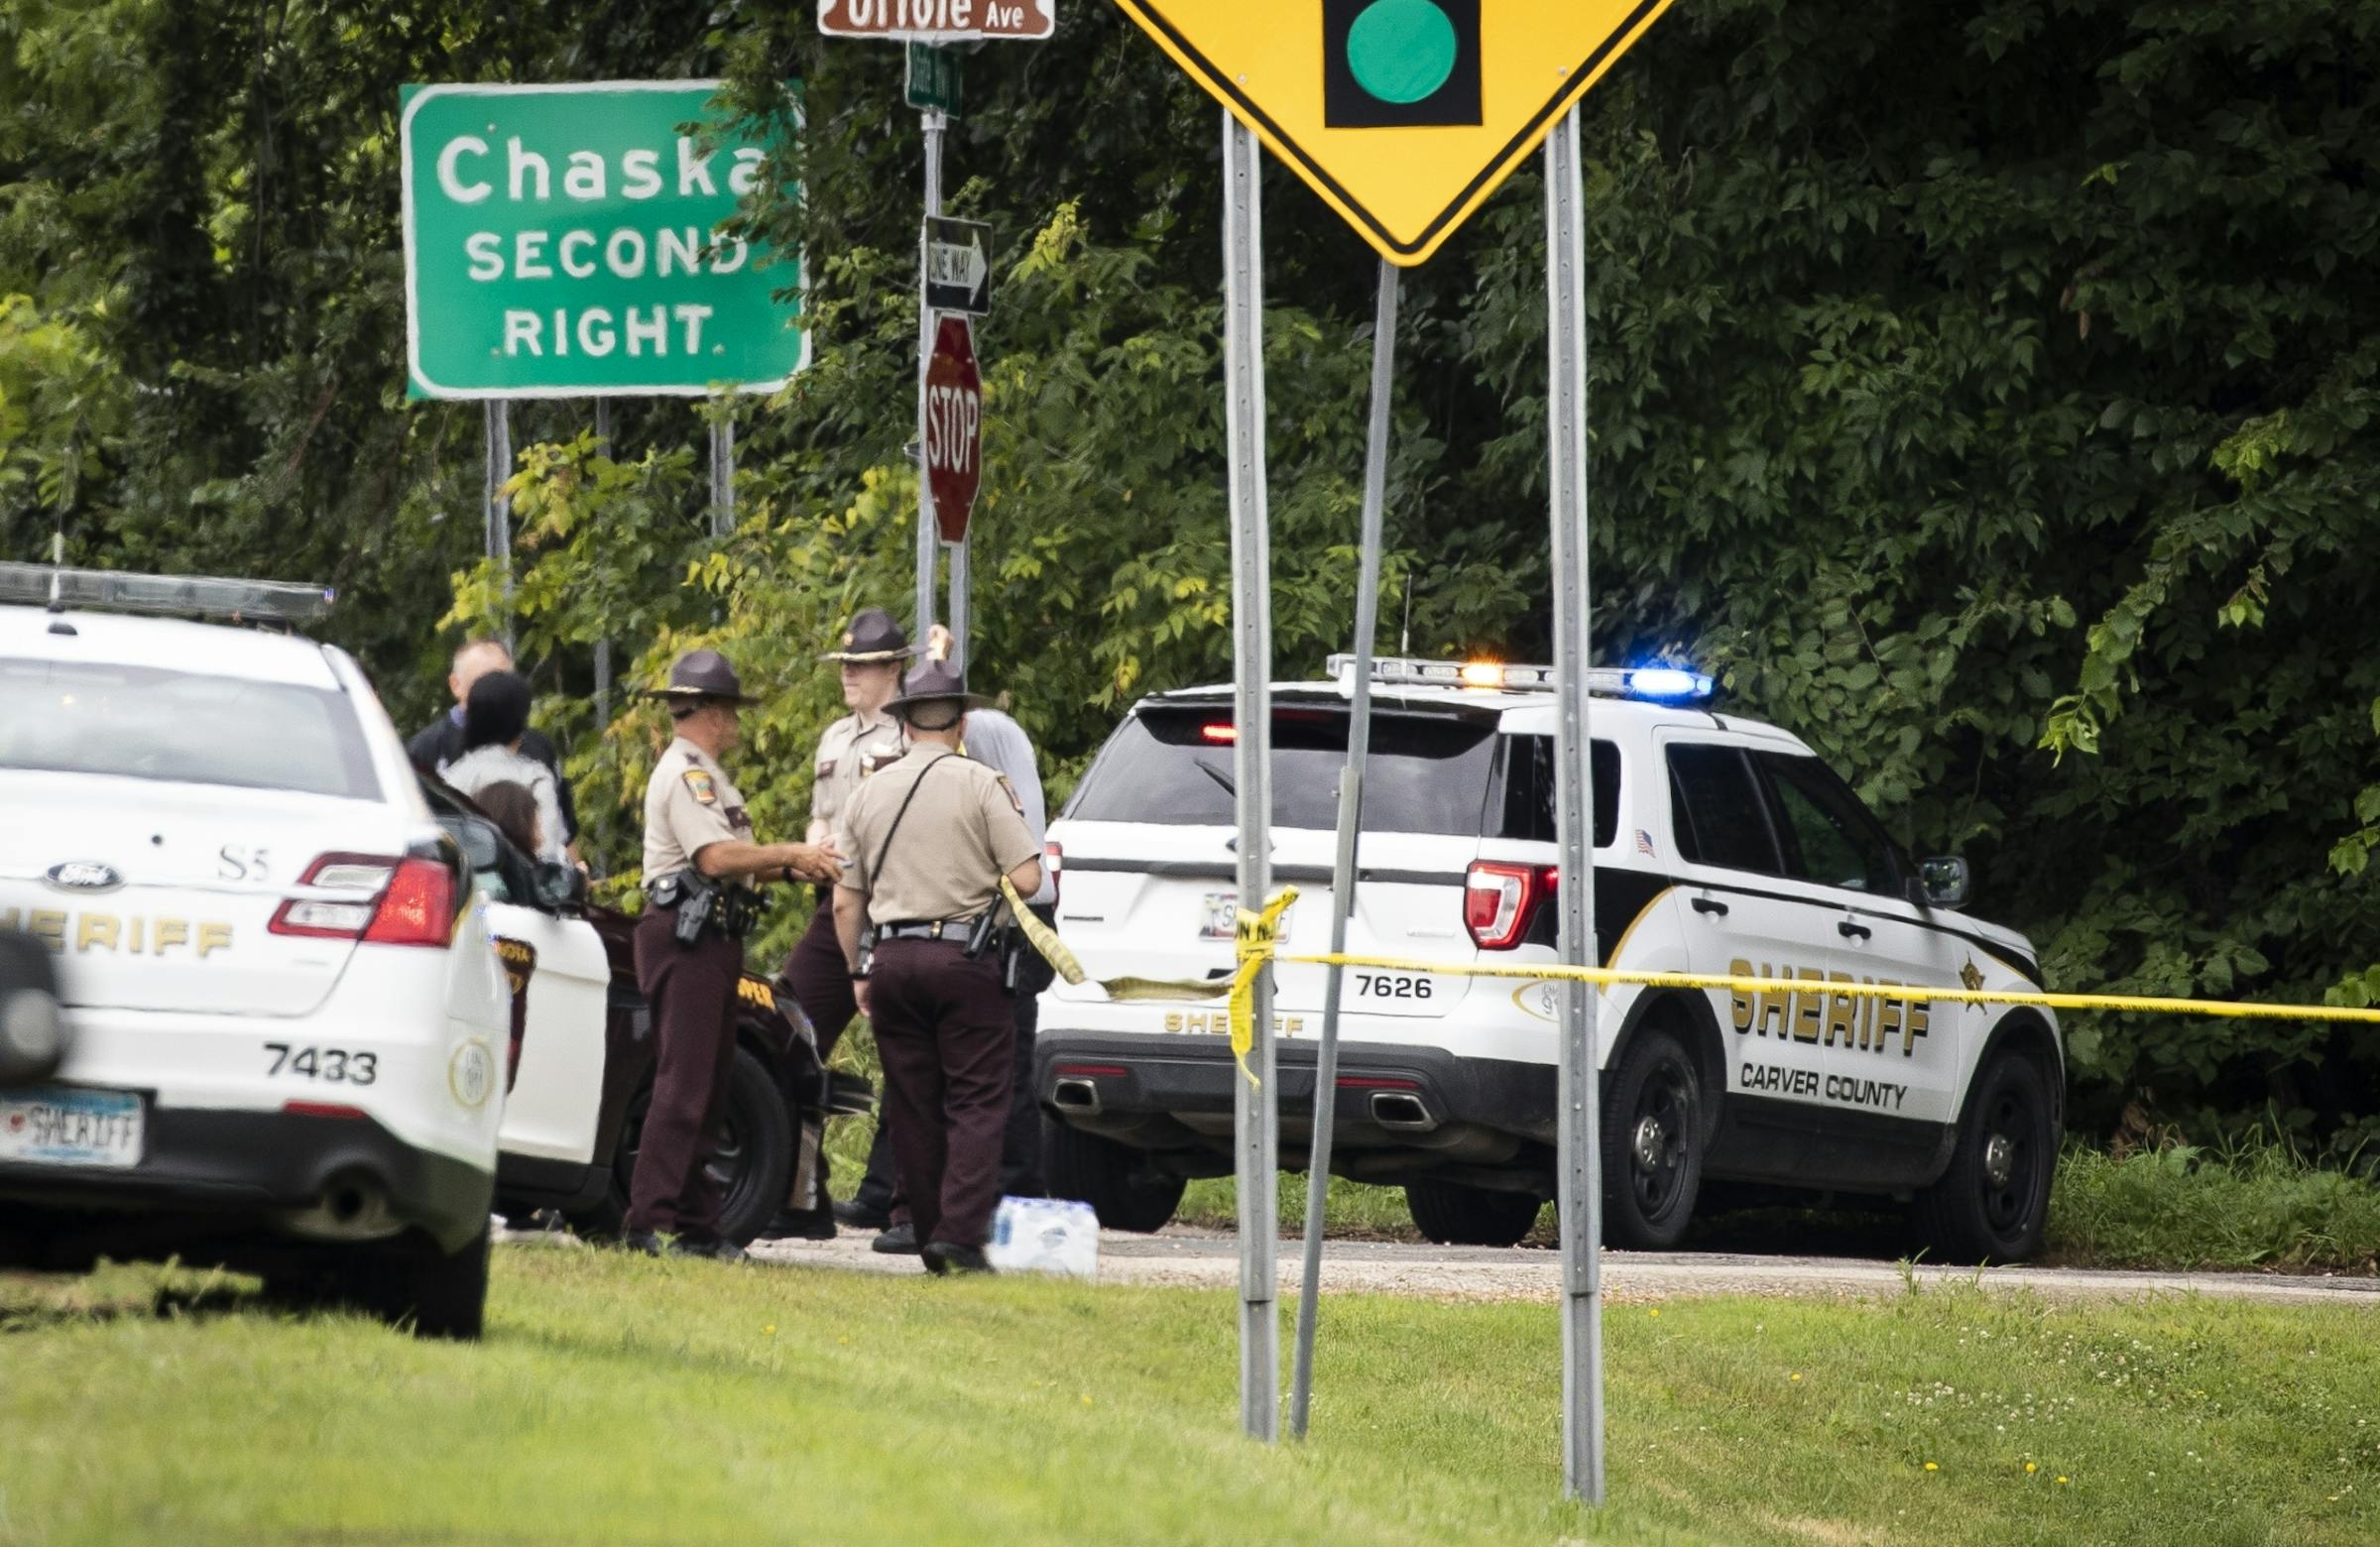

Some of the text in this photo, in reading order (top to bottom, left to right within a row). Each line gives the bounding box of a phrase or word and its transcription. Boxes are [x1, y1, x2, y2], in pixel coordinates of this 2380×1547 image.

[986, 6, 1025, 29] Ave
[436, 136, 768, 204] Chaska
[465, 226, 749, 281] SECOND
[504, 304, 714, 359] RIGHT
[927, 384, 979, 474] STOP
[0, 905, 234, 958] ERIFF
[1355, 974, 1433, 999] 7626
[263, 1042, 379, 1086] 7433
[1740, 1062, 1909, 1111] CARVER COUNTY
